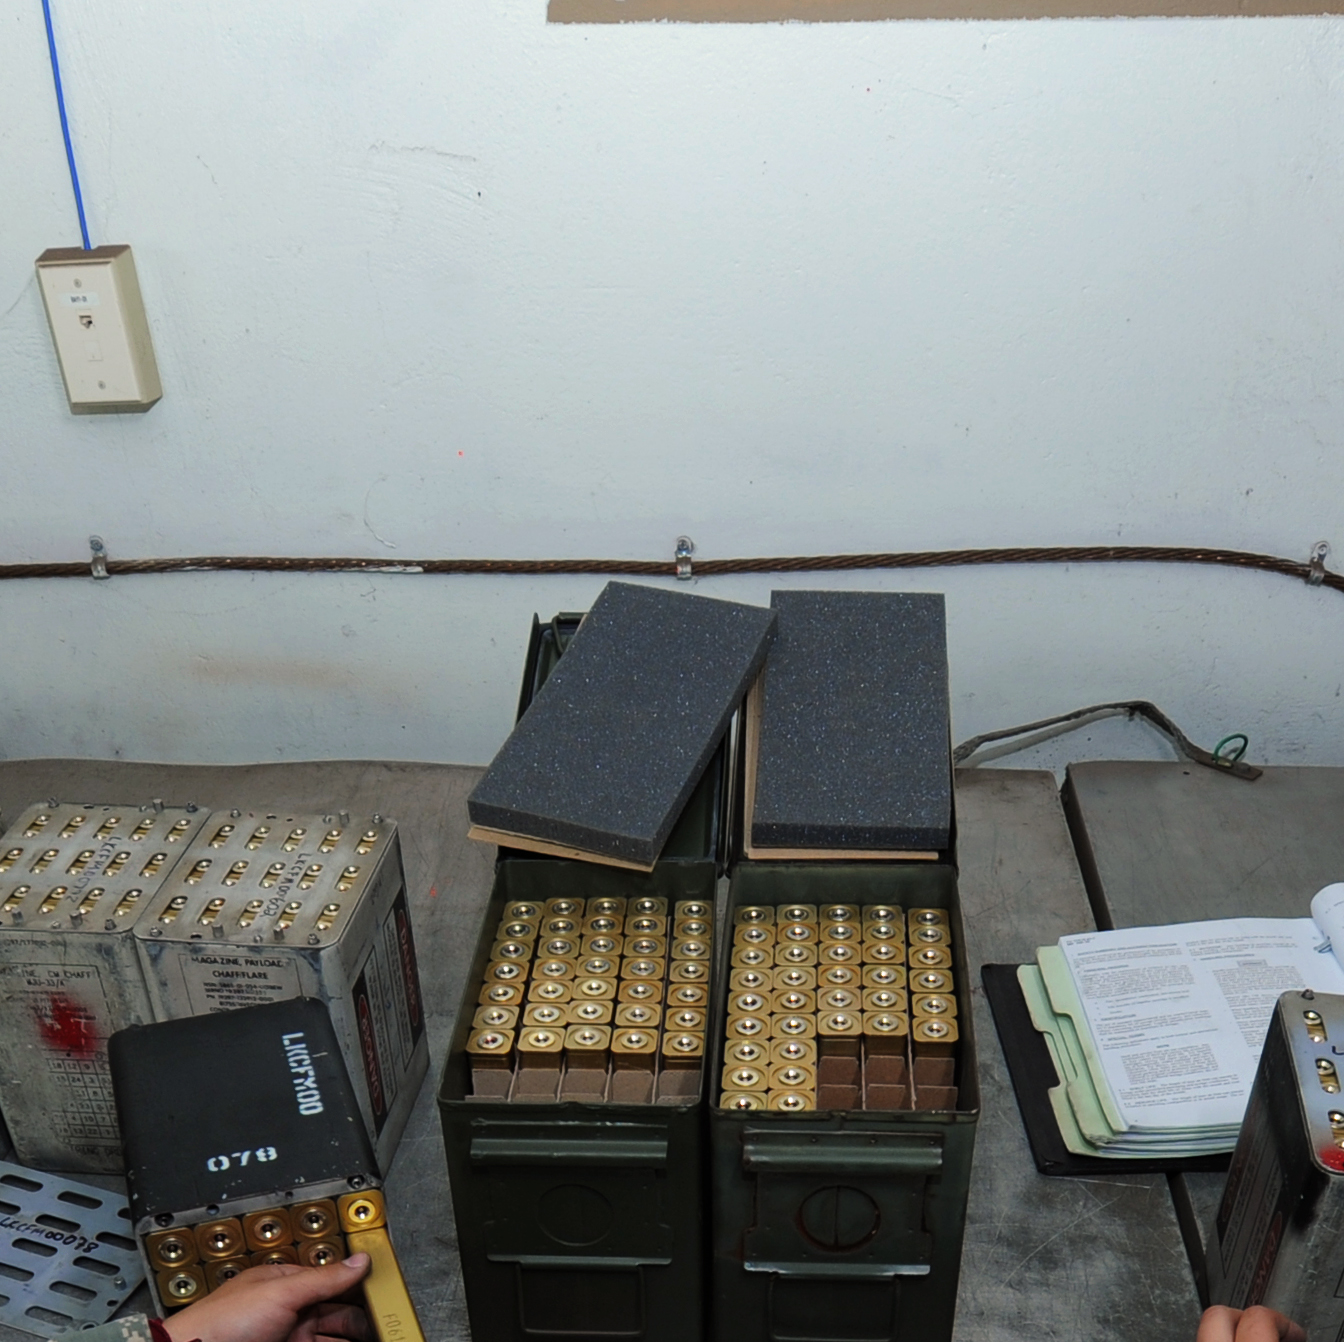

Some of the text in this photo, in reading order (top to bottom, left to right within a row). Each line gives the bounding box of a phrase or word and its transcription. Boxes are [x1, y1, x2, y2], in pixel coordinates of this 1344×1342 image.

[282, 1032, 324, 1115] LKCFM00
[207, 1147, 278, 1172] 078
[0, 1217, 99, 1253] LKCFM00078
